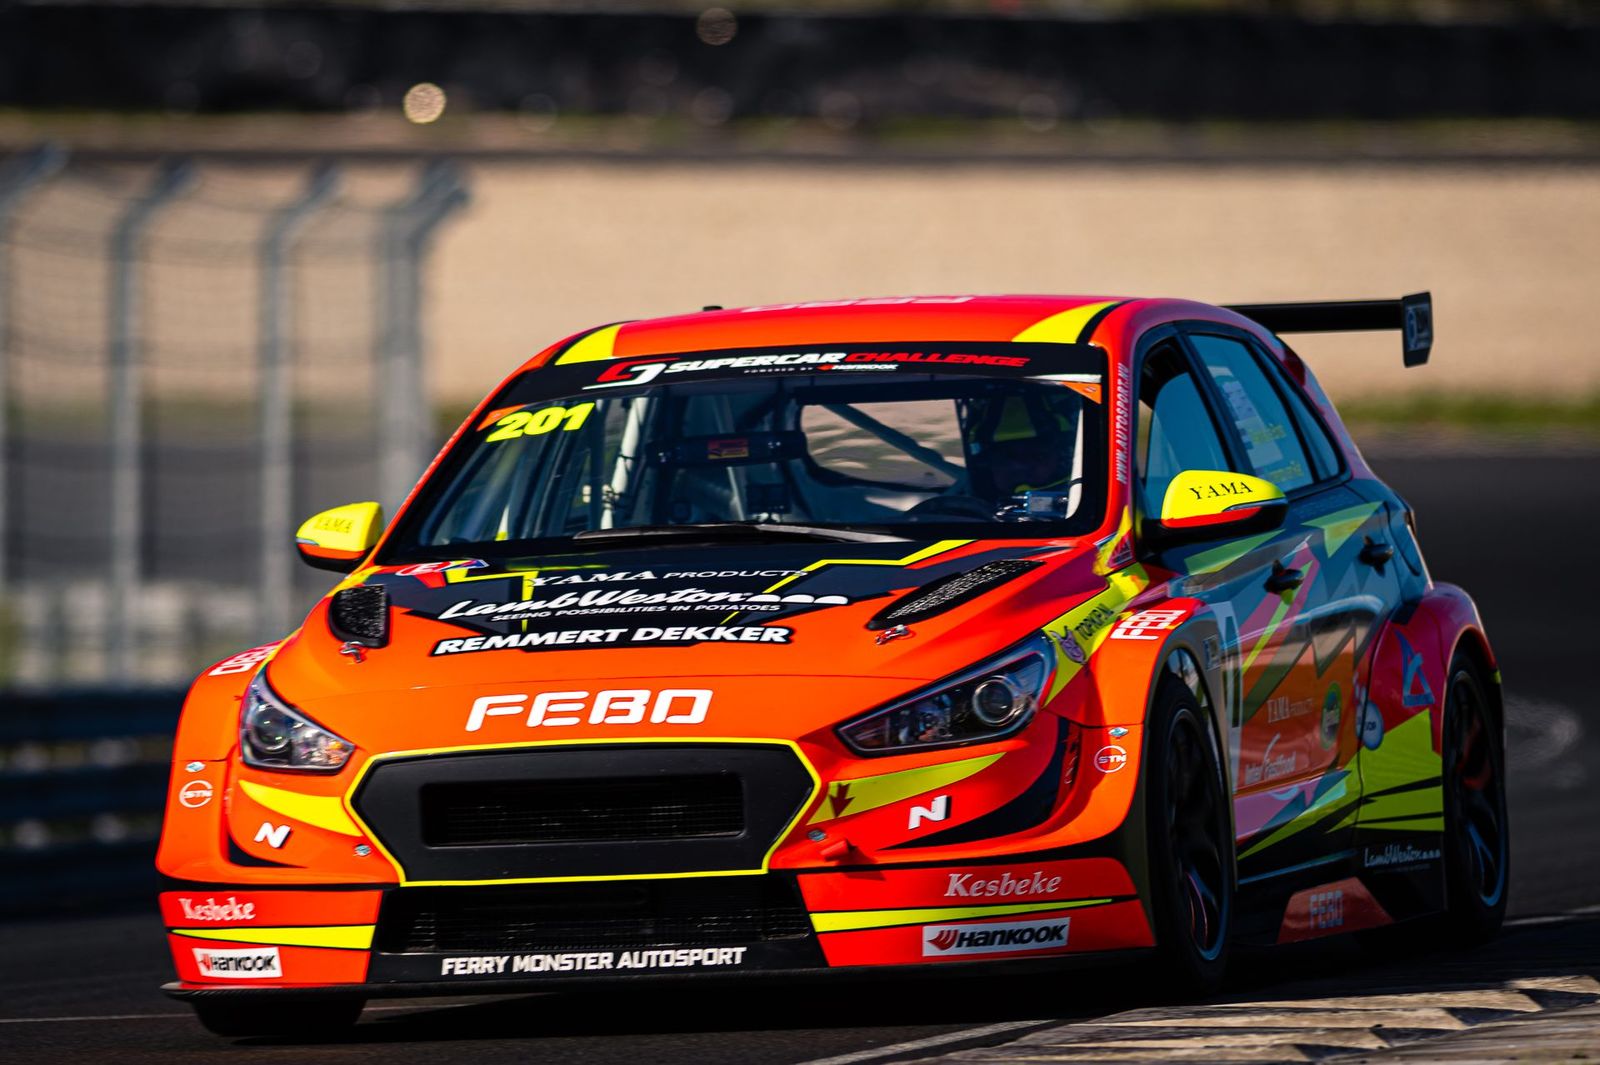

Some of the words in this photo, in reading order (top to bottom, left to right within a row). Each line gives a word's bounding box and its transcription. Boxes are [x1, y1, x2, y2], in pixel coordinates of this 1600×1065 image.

[663, 352, 848, 374] SUPERCAR
[846, 351, 1031, 368] CHALLENGE
[486, 402, 595, 443] 201
[1189, 481, 1253, 501] YAMA
[529, 570, 657, 587] YAMA
[664, 569, 809, 579] PRODUCTS
[491, 610, 549, 621] SEEING
[549, 604, 668, 618] POSSIBILITIES
[671, 604, 692, 613] IN
[694, 602, 781, 613] POTATOES
[434, 628, 630, 655] REMMERT
[632, 625, 792, 643] DEKKER
[465, 688, 714, 732] FEBO
[944, 870, 1063, 898] Kesbeke
[179, 897, 256, 922] Kesbeke
[441, 954, 509, 977] FERRY
[512, 952, 614, 973] MONSTER
[616, 947, 748, 970] AUTOSPORT
